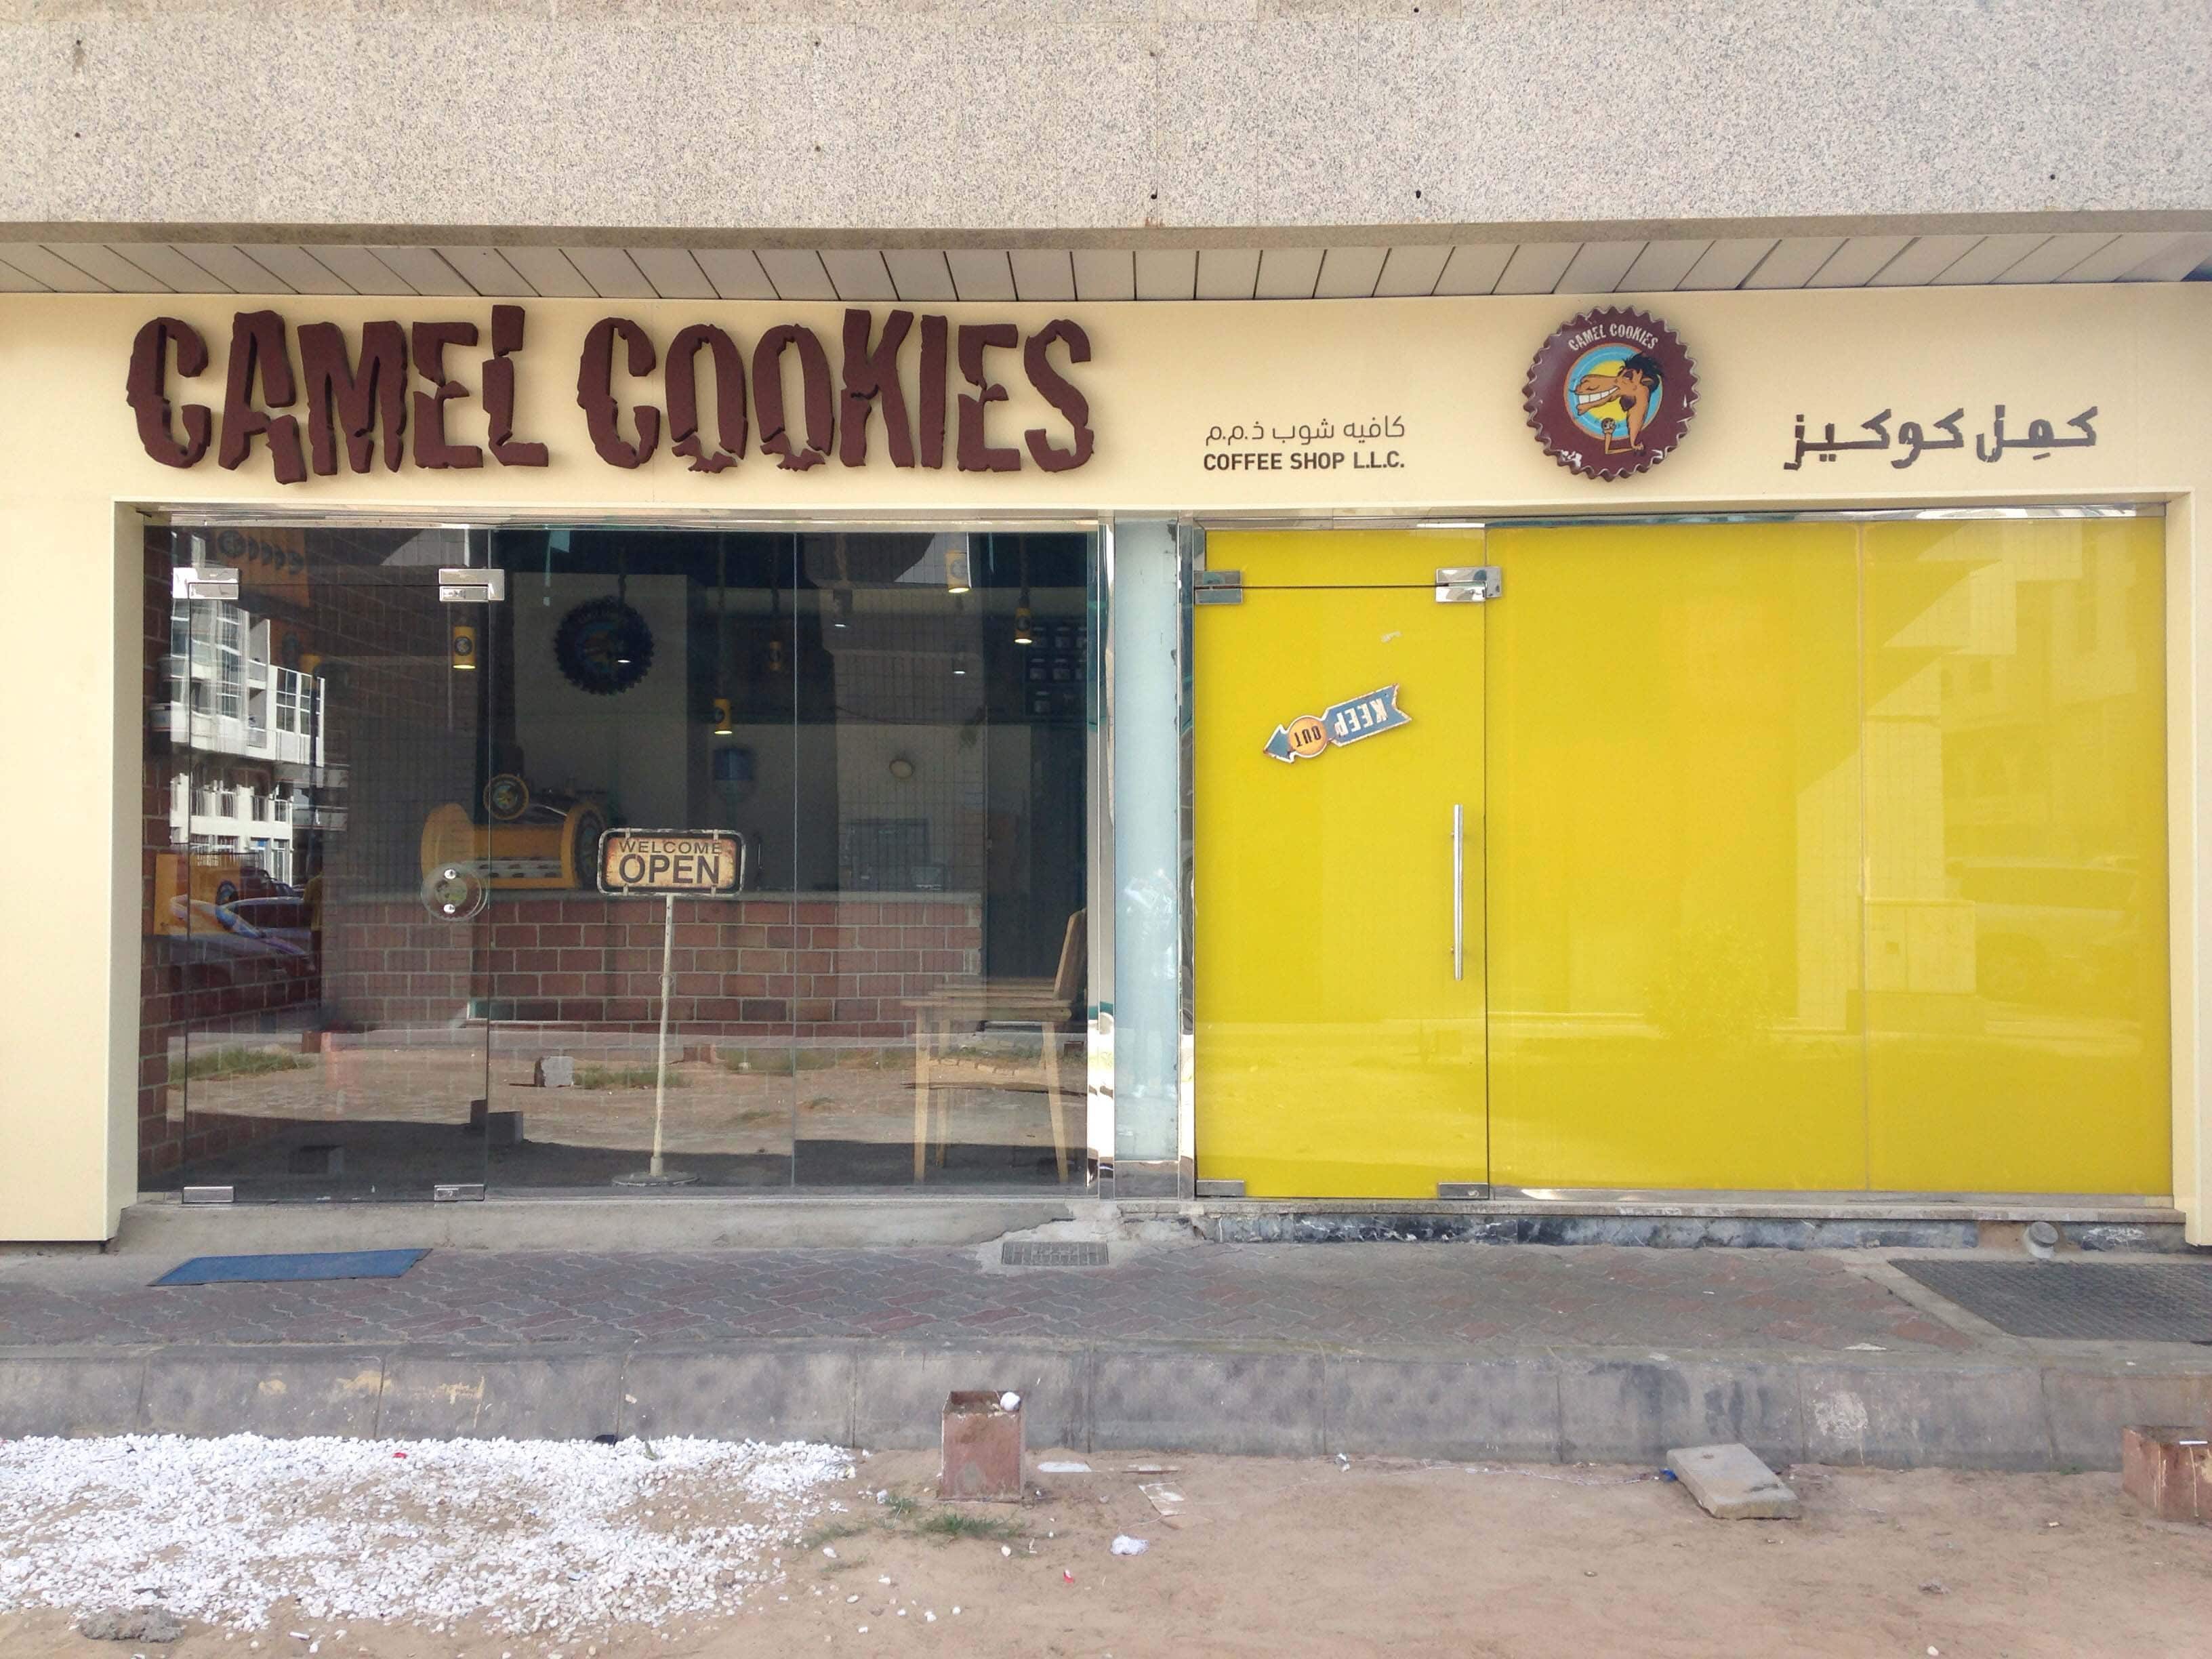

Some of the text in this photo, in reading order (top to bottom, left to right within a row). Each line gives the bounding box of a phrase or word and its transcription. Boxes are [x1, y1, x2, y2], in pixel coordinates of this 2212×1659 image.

[1568, 323, 1659, 351] CAMEL COOKIES
[125, 304, 1095, 484] CAMEL COOKIES
[1272, 418, 1334, 445] شوب
[1343, 415, 1405, 444] كافيه
[1784, 407, 1965, 470] كوكيز
[1204, 451, 1405, 470] COFFEE SHOP L.L.C.
[1294, 698, 1389, 747] KEEP OUT
[619, 840, 723, 855] WELCOME
[619, 854, 720, 884] OPEN
